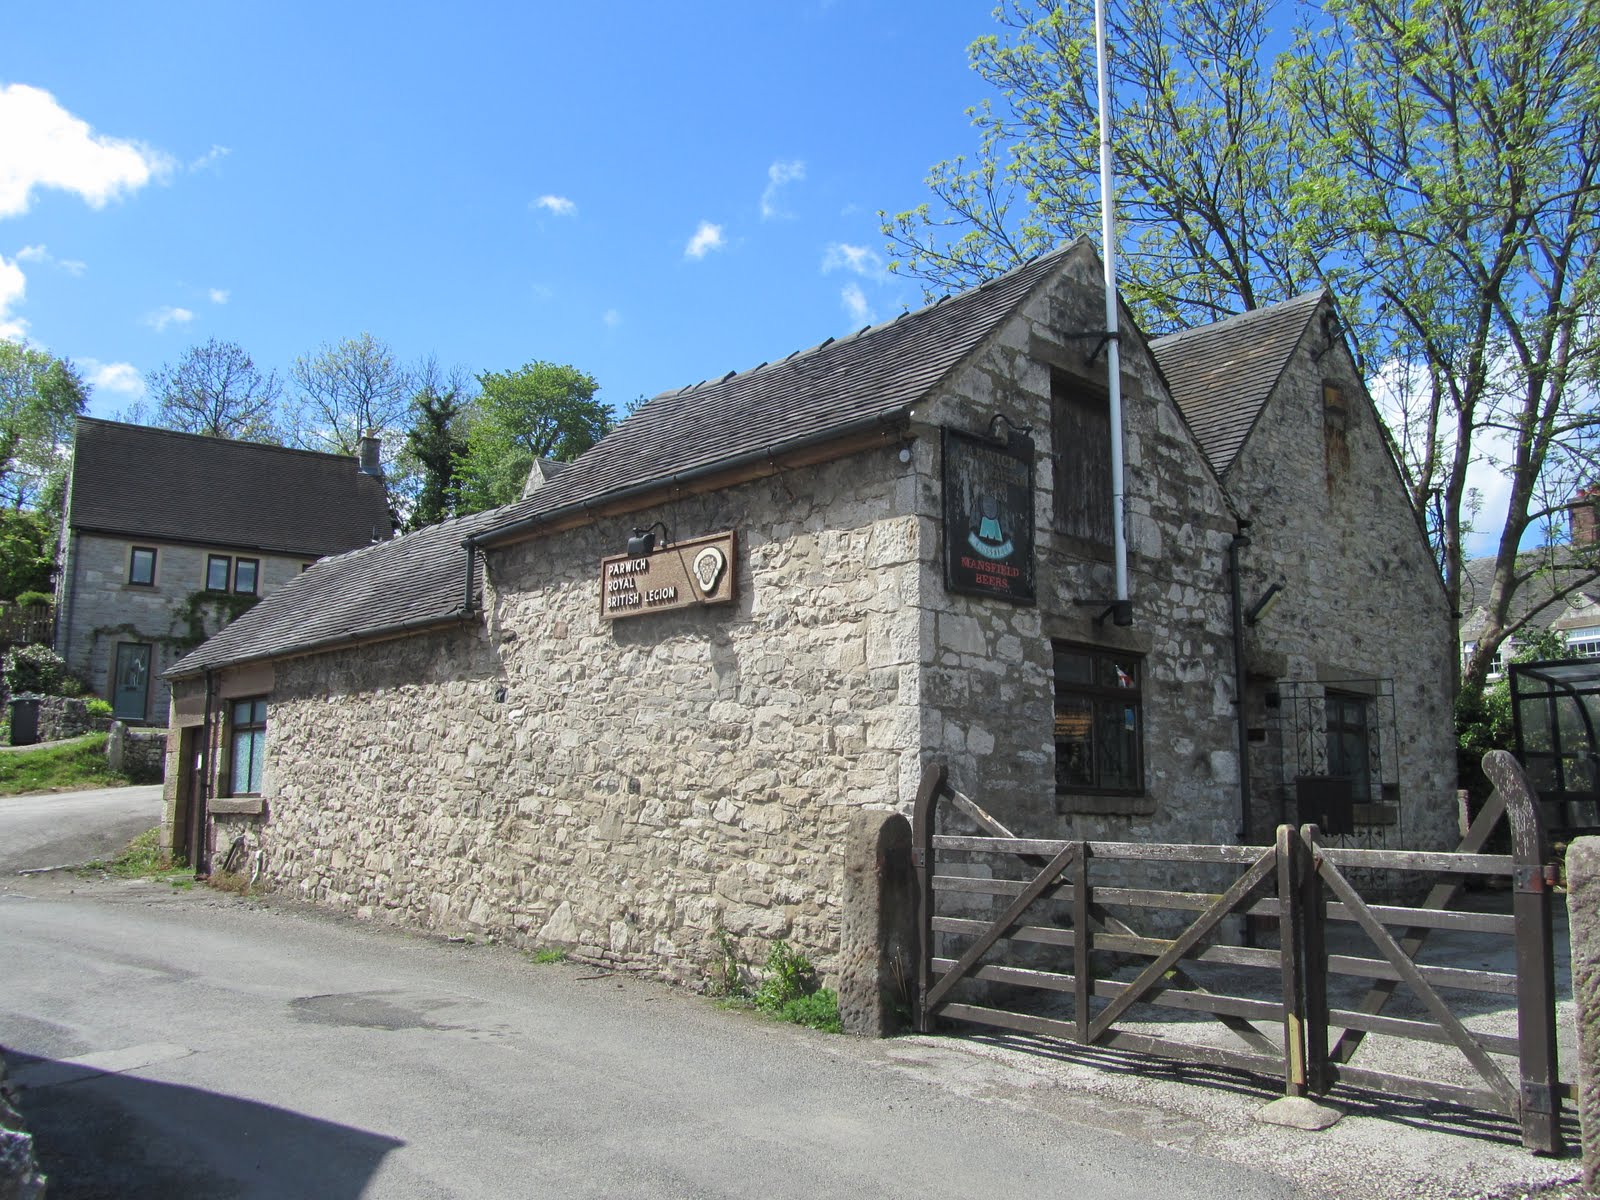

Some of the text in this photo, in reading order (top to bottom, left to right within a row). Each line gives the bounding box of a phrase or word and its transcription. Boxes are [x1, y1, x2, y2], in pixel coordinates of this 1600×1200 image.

[609, 559, 646, 576] PARWICH
[961, 556, 1020, 577] MANSFIELD
[608, 578, 634, 592] ROYAL
[975, 573, 1008, 589] BEERS
[607, 586, 675, 608] BRITISH LEGION
